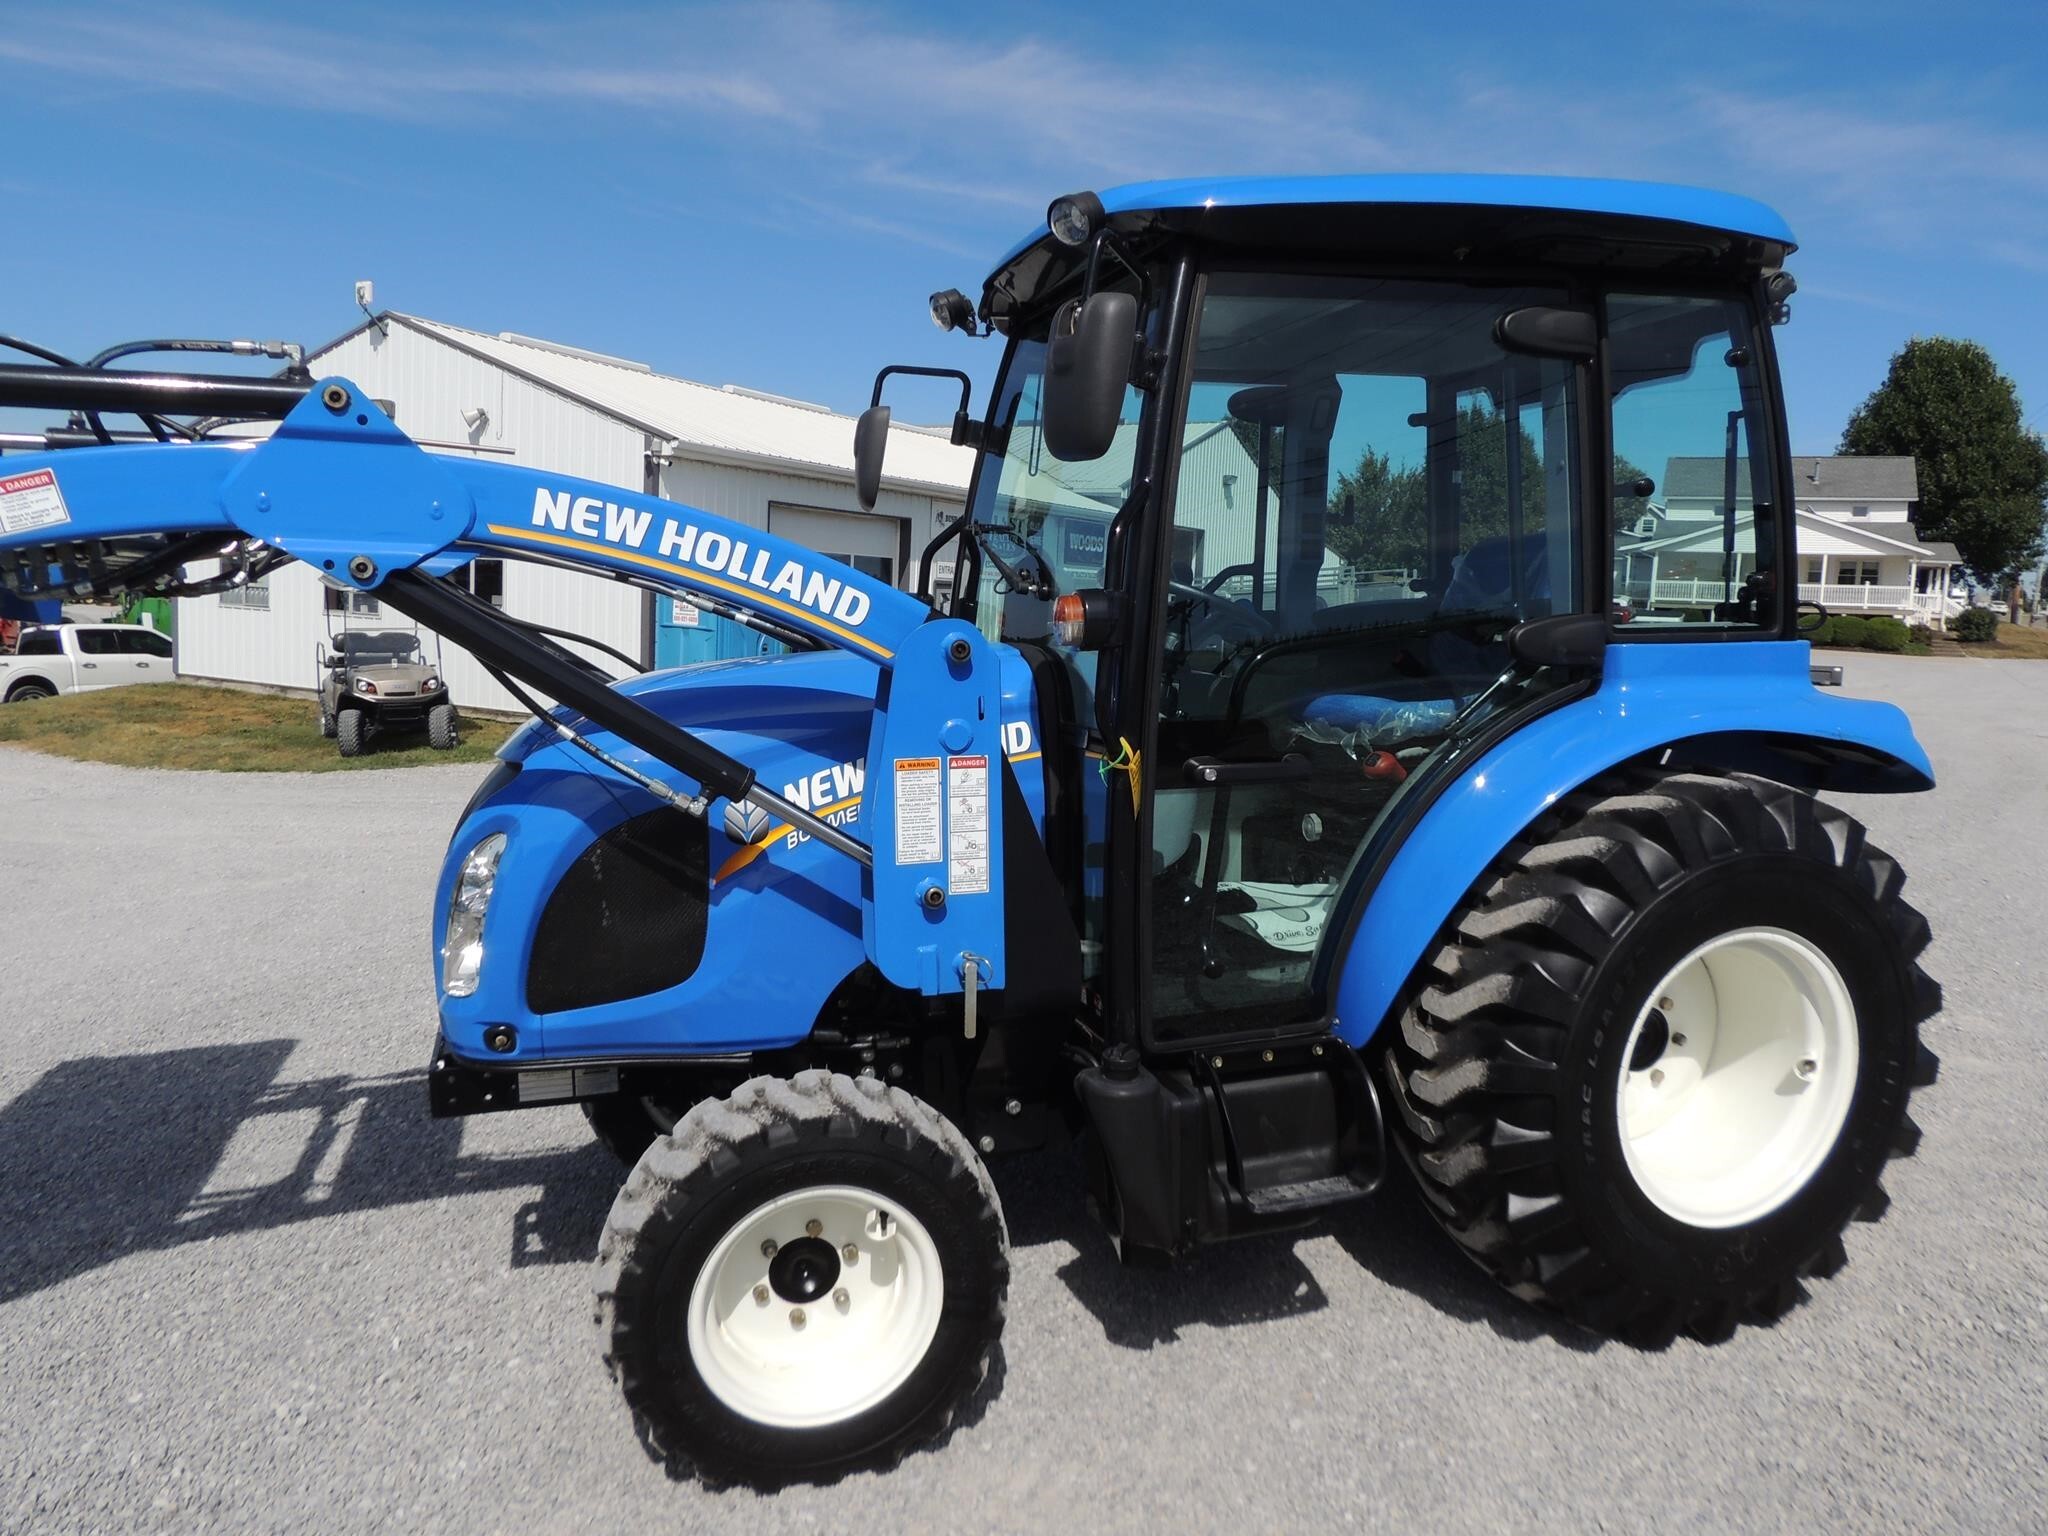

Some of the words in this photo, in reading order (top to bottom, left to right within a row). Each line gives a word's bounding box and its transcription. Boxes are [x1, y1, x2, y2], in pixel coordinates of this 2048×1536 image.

[6, 475, 49, 490] DANGER
[1070, 532, 1104, 553] WOODS
[530, 487, 653, 548] NEW
[658, 524, 872, 627] HOLLAND
[938, 564, 954, 577] ENTRA
[957, 759, 985, 767] DANGER
[784, 757, 865, 811] NEW
[787, 804, 861, 850] BOME
